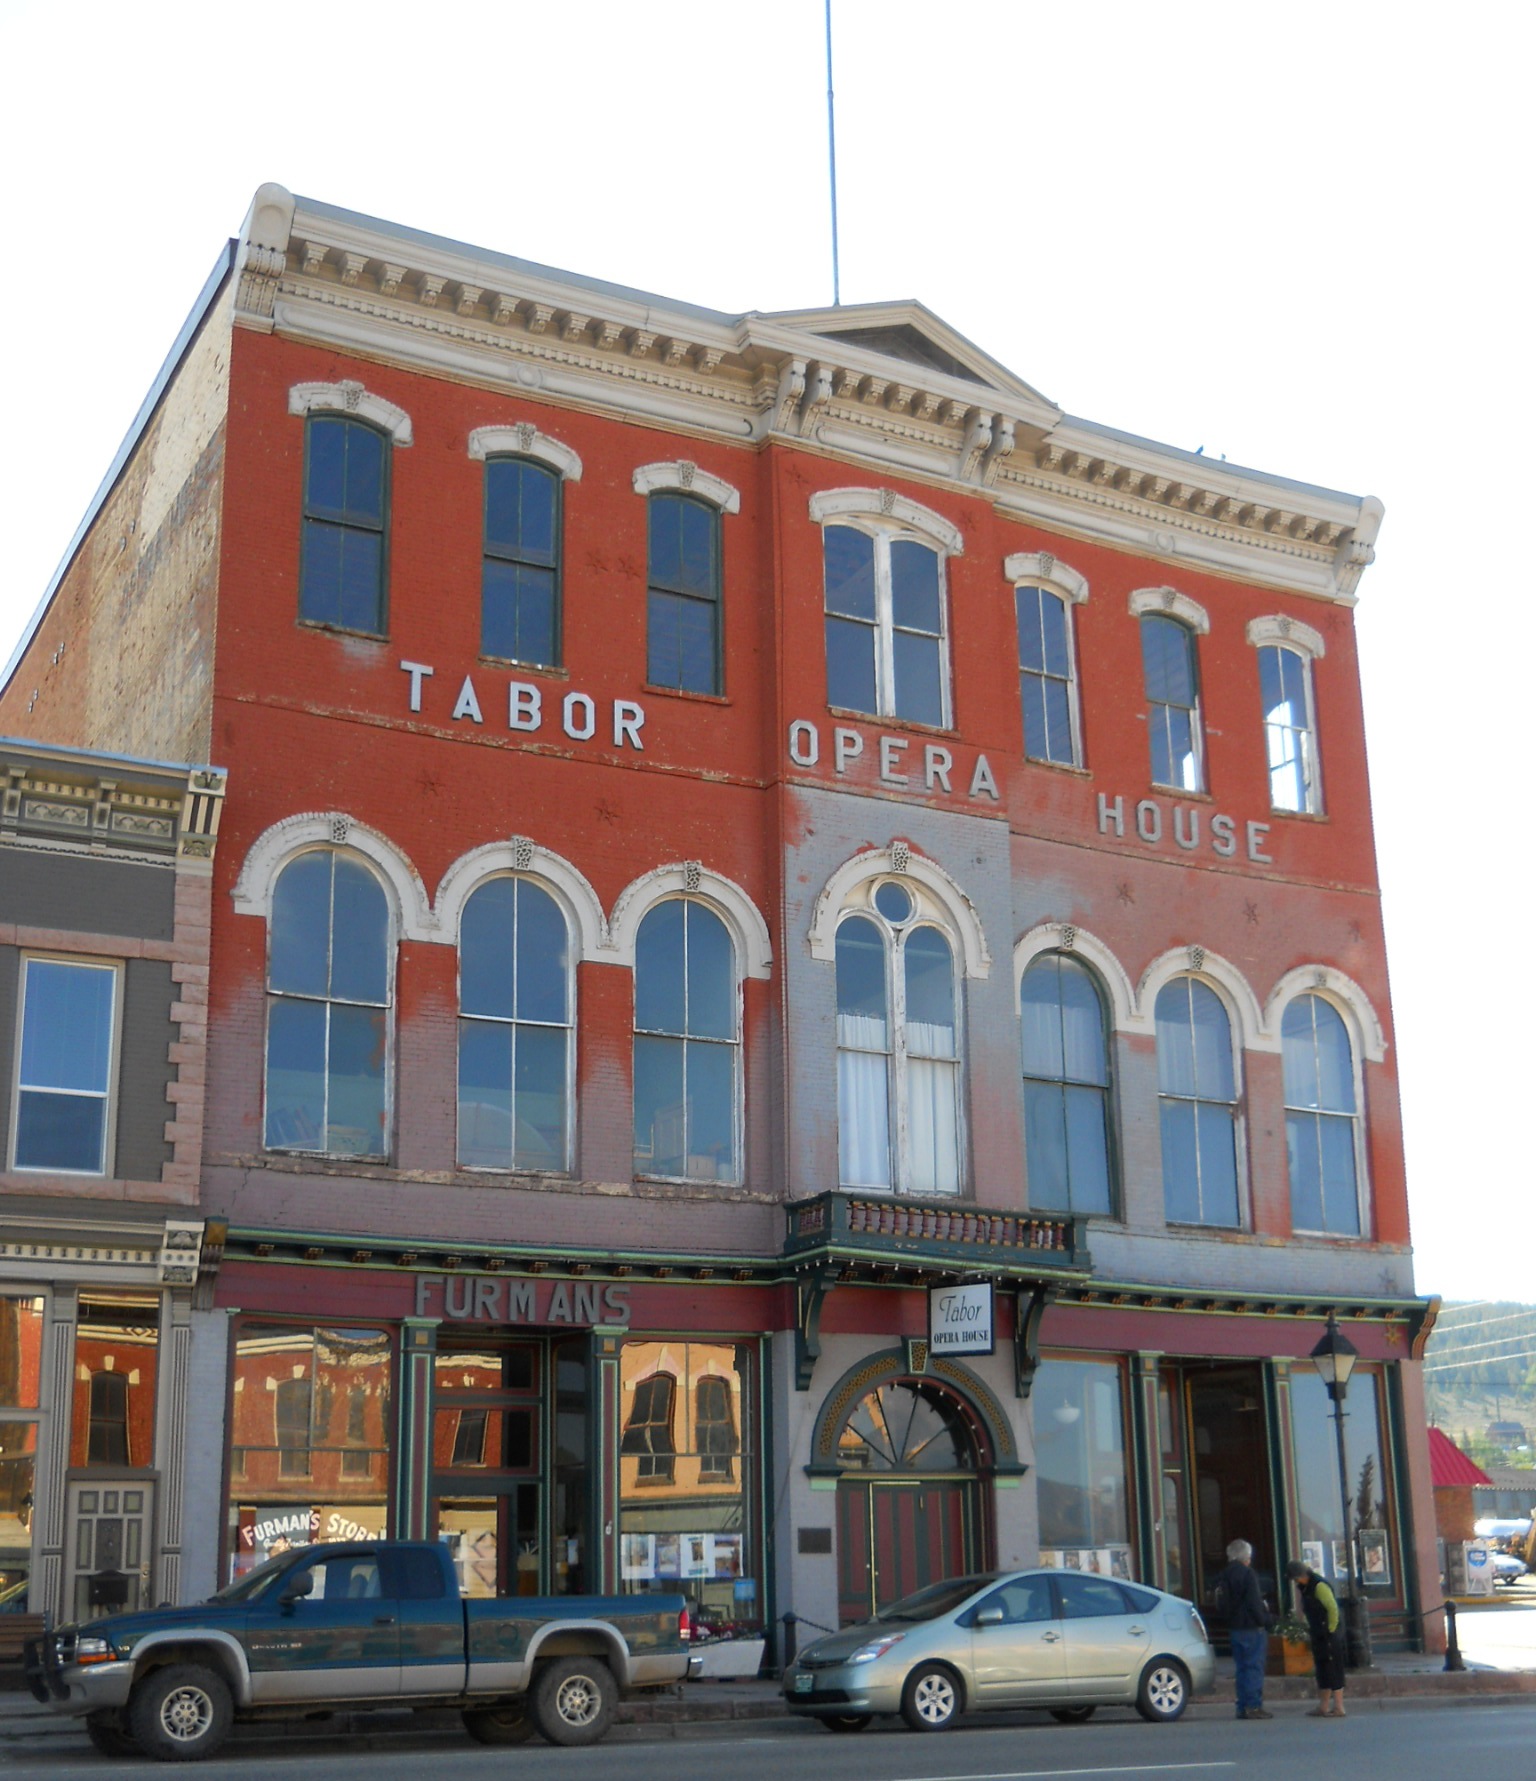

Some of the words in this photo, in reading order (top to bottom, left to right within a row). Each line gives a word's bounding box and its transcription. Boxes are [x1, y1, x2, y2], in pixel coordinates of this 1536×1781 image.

[401, 660, 645, 750] TABOR
[789, 719, 999, 800] OPERA
[1097, 792, 1273, 864] HOUSE
[415, 1274, 631, 1324] FURMANS
[939, 1294, 982, 1323] Tabor
[933, 1331, 960, 1344] OPERA
[962, 1329, 989, 1343] HOUSE
[242, 1510, 321, 1546] FURMAN'S
